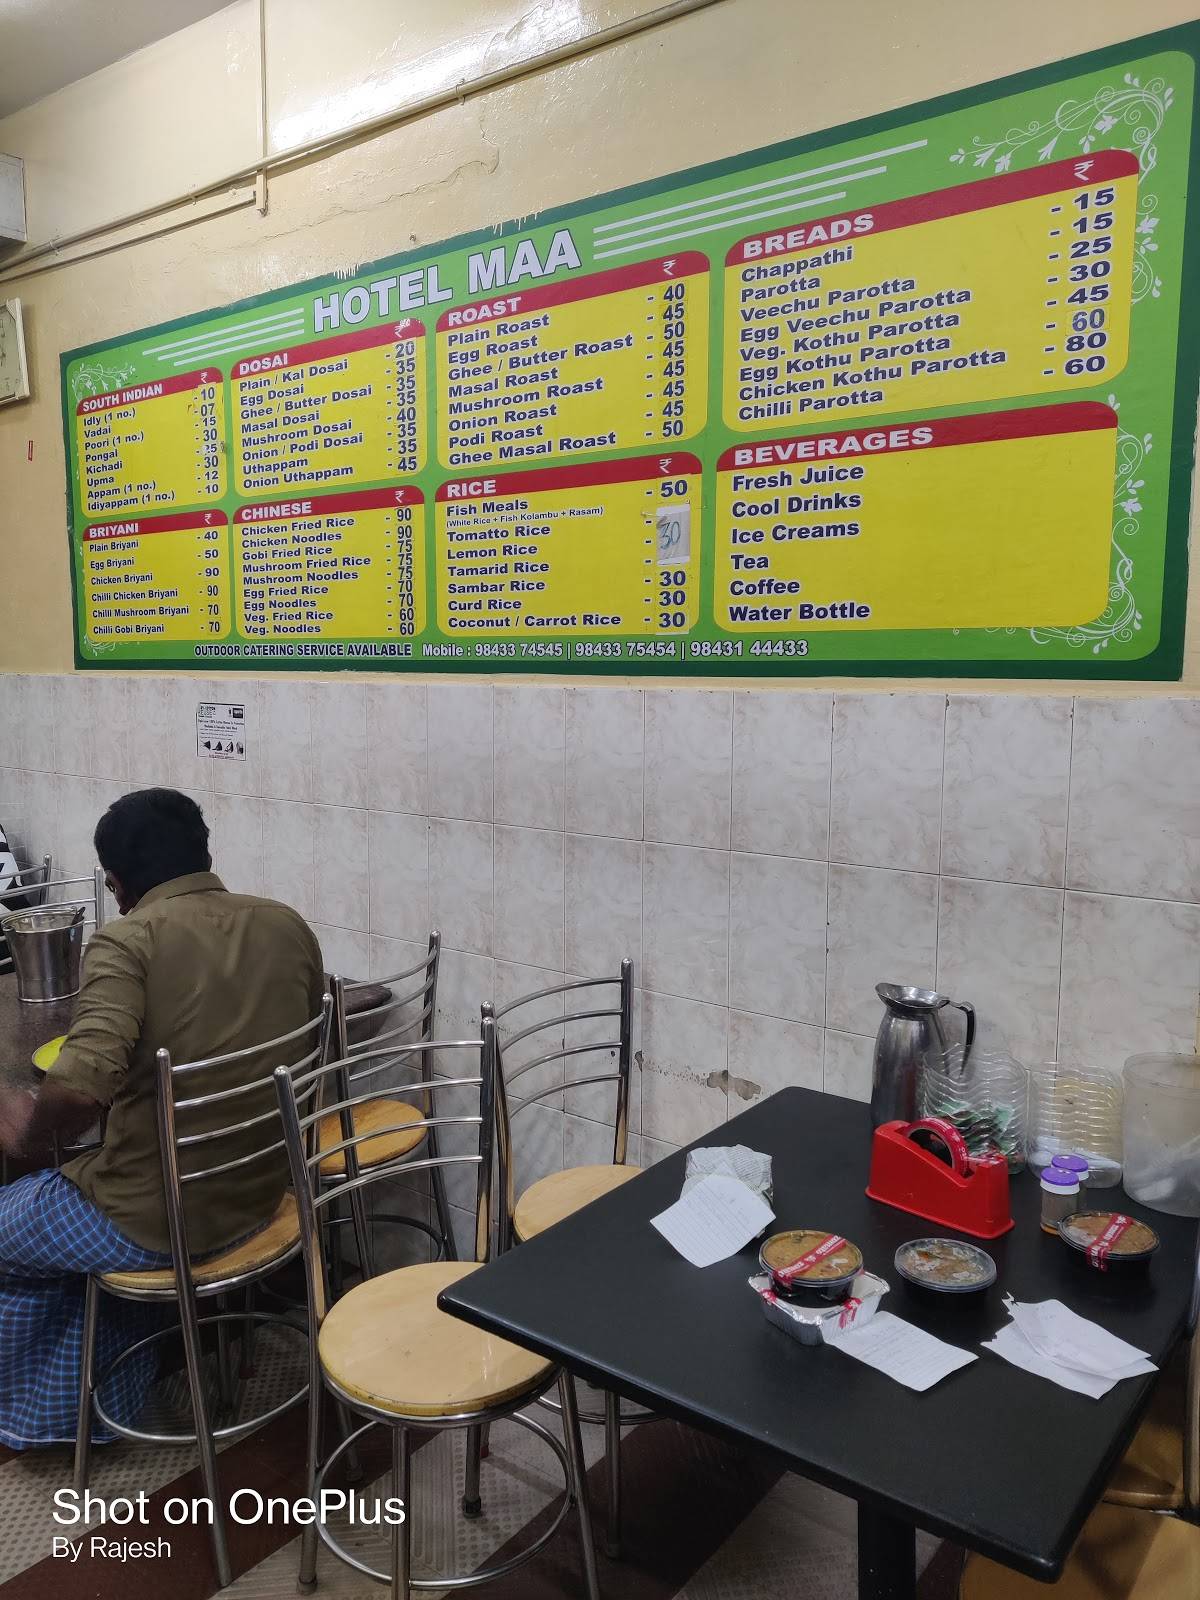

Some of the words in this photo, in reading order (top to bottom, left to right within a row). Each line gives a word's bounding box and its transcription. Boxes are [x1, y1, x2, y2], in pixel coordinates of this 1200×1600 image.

[741, 247, 853, 284] Chappathi
[1073, 188, 1115, 210] 15
[743, 214, 874, 259] BREADS
[741, 276, 820, 302] Parotta
[1073, 212, 1113, 234] 15
[314, 264, 453, 333] HOTEL
[468, 228, 582, 294] MAA
[741, 296, 819, 322] Veechu
[828, 278, 915, 305] Parotta
[1071, 236, 1112, 258] 25
[449, 297, 521, 326] ROAST
[741, 324, 779, 344] Egg
[787, 307, 870, 334] Veechu
[879, 289, 971, 317] Parotta
[1069, 261, 1110, 282] 30
[448, 329, 489, 346] Plain
[497, 314, 549, 336] Roast
[741, 344, 786, 362] Veg.
[793, 329, 859, 353] Kothu
[869, 312, 960, 339] Parotta
[1068, 285, 1109, 305] 45
[449, 348, 479, 363] Egg
[487, 335, 538, 356] Roast
[740, 363, 779, 383] Egg
[787, 351, 851, 374] Kothu
[860, 336, 950, 362] Parotta
[1071, 308, 1105, 331] 60
[240, 353, 288, 374] DOSAI
[449, 365, 492, 380] Ghee
[509, 349, 568, 369] Butter
[575, 334, 632, 356] Roast
[740, 378, 824, 400] Chicken
[833, 365, 901, 388] Kothu
[911, 349, 1006, 375] Parotta
[1066, 333, 1107, 352] 80
[240, 379, 270, 391] Plain
[282, 369, 304, 382] Kal
[309, 360, 348, 376] Dosai
[449, 379, 498, 397] Masal
[505, 367, 558, 387] Roast
[83, 394, 119, 411] SOUTH
[123, 384, 162, 402] INDIAN
[241, 394, 263, 406] Egg
[268, 384, 304, 399] Dosai
[449, 391, 540, 414] Mushroom
[547, 378, 603, 398] Roast
[739, 401, 791, 421] Chilli
[799, 389, 883, 413] Parotta
[1065, 356, 1106, 375] 60
[241, 407, 273, 419] Ghee
[285, 395, 327, 411] Butter
[332, 385, 372, 401] Dosai
[84, 416, 101, 426] Idly
[241, 419, 278, 433] Masal
[283, 411, 320, 426] Dosai
[449, 416, 498, 431] Onion
[505, 404, 556, 423] Roast
[84, 426, 110, 438] Vadai
[242, 428, 308, 447] Mushroom
[314, 420, 352, 435] Dosai
[449, 431, 484, 448] Podi
[492, 424, 543, 443] Roast
[86, 449, 118, 462] Pongal
[243, 448, 278, 461] Onion
[290, 440, 318, 453] Podi
[324, 433, 362, 448] Dosai
[449, 450, 492, 465] Ghee
[500, 440, 552, 458] Masal
[560, 431, 616, 451] Roast
[735, 427, 933, 465] BEVERAGES
[87, 461, 122, 474] Kichadi
[243, 457, 308, 475] Uthappam
[244, 475, 279, 488] Onion
[284, 466, 353, 482] Uthappam
[87, 477, 114, 487] Upma
[448, 480, 496, 497] RICE
[733, 471, 792, 491] Fresh
[800, 466, 864, 484] Juice
[447, 506, 477, 516] Fish
[483, 500, 528, 513] Meals
[661, 480, 687, 498] 50
[733, 499, 779, 517] Cool
[788, 493, 861, 512] Drinks
[242, 502, 312, 520] CHINESE
[447, 517, 471, 528] (White
[500, 513, 518, 522] Fish
[520, 511, 558, 520] Kolambu
[569, 507, 603, 517] Rasam)
[89, 523, 138, 537] BRIYANI
[242, 526, 287, 535] Chicken
[291, 522, 321, 531] Fried
[326, 518, 355, 527] Rice
[448, 529, 509, 542] Tomatto
[515, 526, 550, 537] Rice
[732, 528, 764, 543] Ice
[772, 522, 859, 541] Creams
[111, 540, 138, 550] Briyani
[242, 538, 287, 548] Chicken
[292, 532, 341, 543] Noodles
[243, 551, 267, 560] Gobi
[272, 550, 300, 558] Fried
[305, 546, 332, 555] Rice
[448, 547, 496, 559] Lemon
[502, 545, 537, 555] Rice
[731, 554, 769, 569] Tea
[91, 561, 104, 570] Egg
[107, 557, 134, 567] Briyani
[243, 561, 302, 572] Mushroom
[307, 558, 337, 568] Fried
[342, 557, 371, 566] Rice
[448, 564, 508, 576] Tamarid
[514, 562, 549, 573] Rice
[91, 576, 121, 584] Chicken
[125, 573, 152, 583] Briyani
[448, 582, 505, 594] Sambar
[510, 581, 545, 591] Rice
[659, 571, 686, 586] 30
[730, 579, 800, 595] Coffee
[448, 600, 482, 611] Curd
[488, 599, 521, 610] Rice
[659, 590, 686, 606] 30
[448, 617, 510, 628] Coconut
[525, 616, 576, 626] Carrot
[582, 615, 621, 625] Rice
[659, 612, 685, 627] 30
[729, 606, 791, 621] Water
[800, 603, 870, 620] Bottle
[195, 645, 240, 656] OUTDOOR
[244, 645, 293, 656] CATERING
[297, 645, 343, 656] SERVICE
[347, 644, 411, 656] AVAILABLE
[422, 644, 463, 657] Mobile
[475, 643, 515, 657] 98433
[521, 643, 562, 656] 74545
[575, 642, 622, 656] 98433
[627, 642, 675, 656] 75454
[691, 641, 742, 656] 98431
[749, 641, 807, 656] 44433
